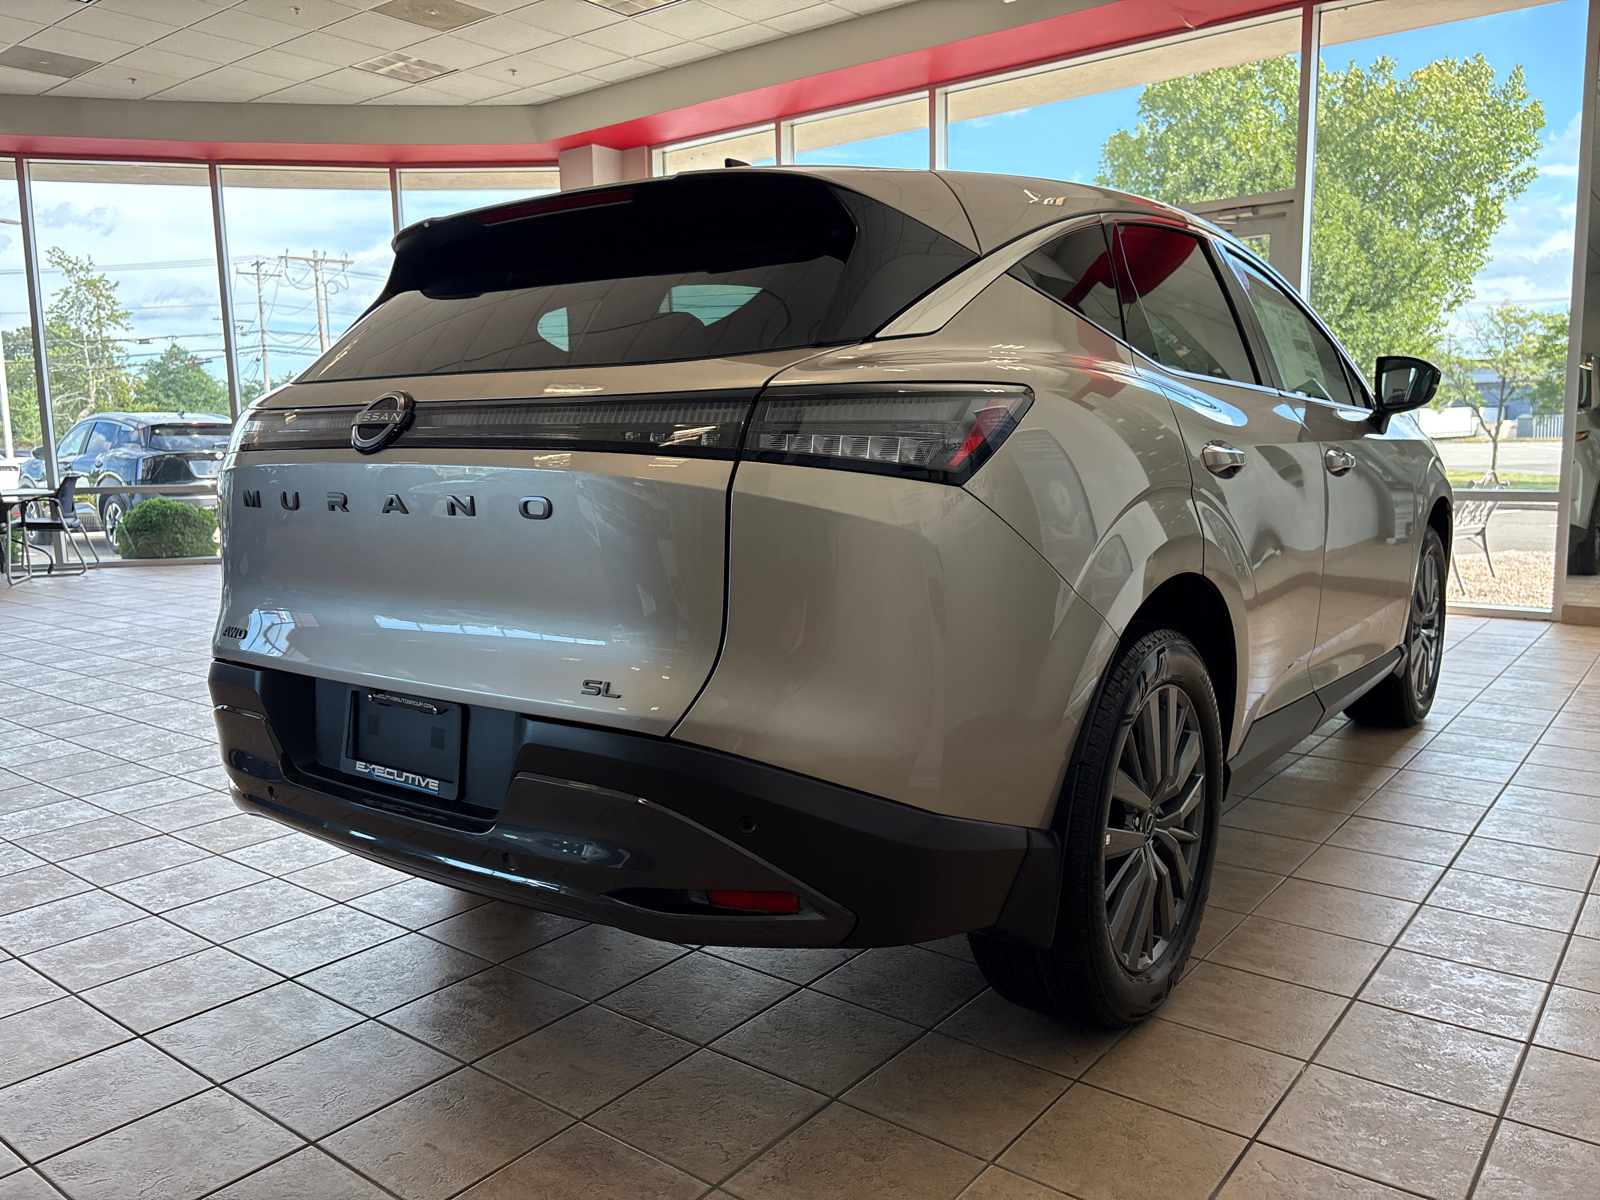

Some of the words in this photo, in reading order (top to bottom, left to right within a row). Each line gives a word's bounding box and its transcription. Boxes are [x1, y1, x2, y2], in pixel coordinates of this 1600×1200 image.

[242, 489, 554, 520] MURANO
[222, 626, 248, 640] AWD
[581, 679, 622, 699] SL
[355, 761, 440, 793] EXECUTIVE
